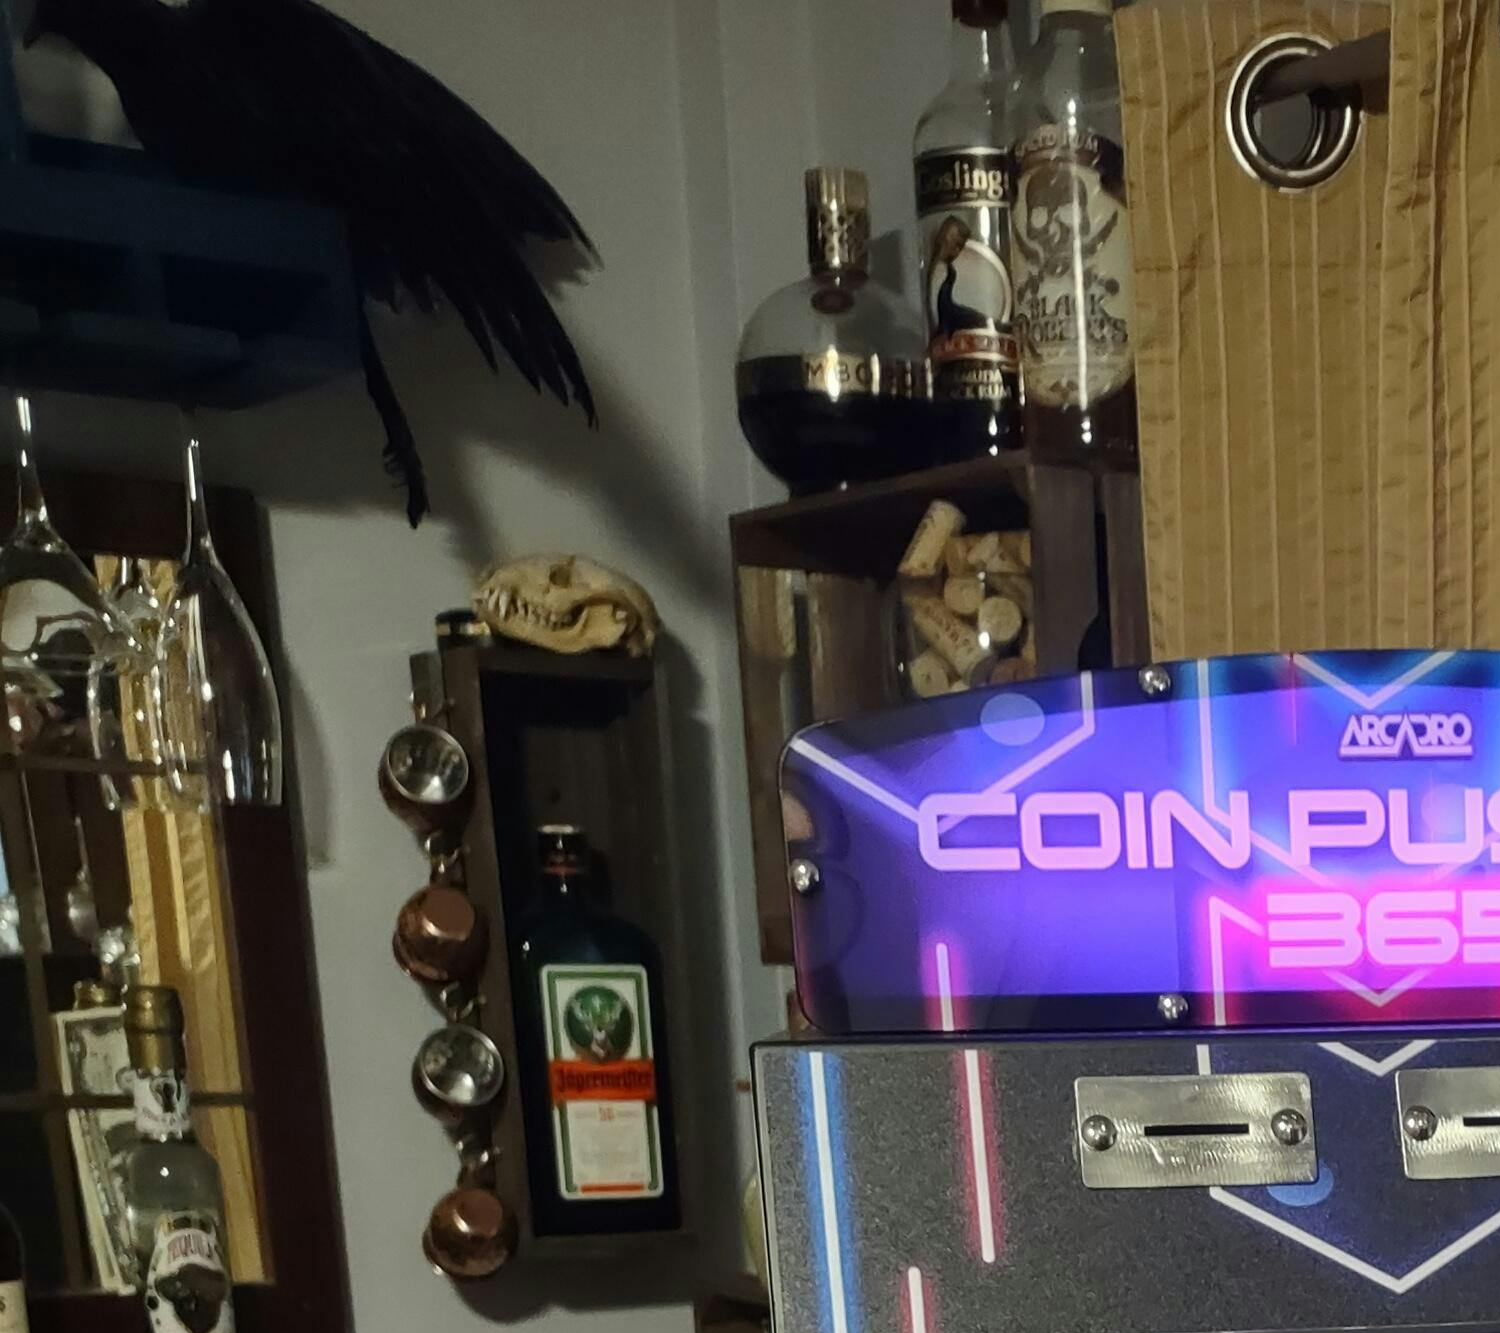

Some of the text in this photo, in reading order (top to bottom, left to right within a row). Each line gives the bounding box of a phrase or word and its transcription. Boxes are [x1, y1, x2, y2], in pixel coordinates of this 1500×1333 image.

[928, 160, 1009, 199] sling
[1030, 293, 1110, 318] BLAK
[918, 789, 1251, 871] COIN
